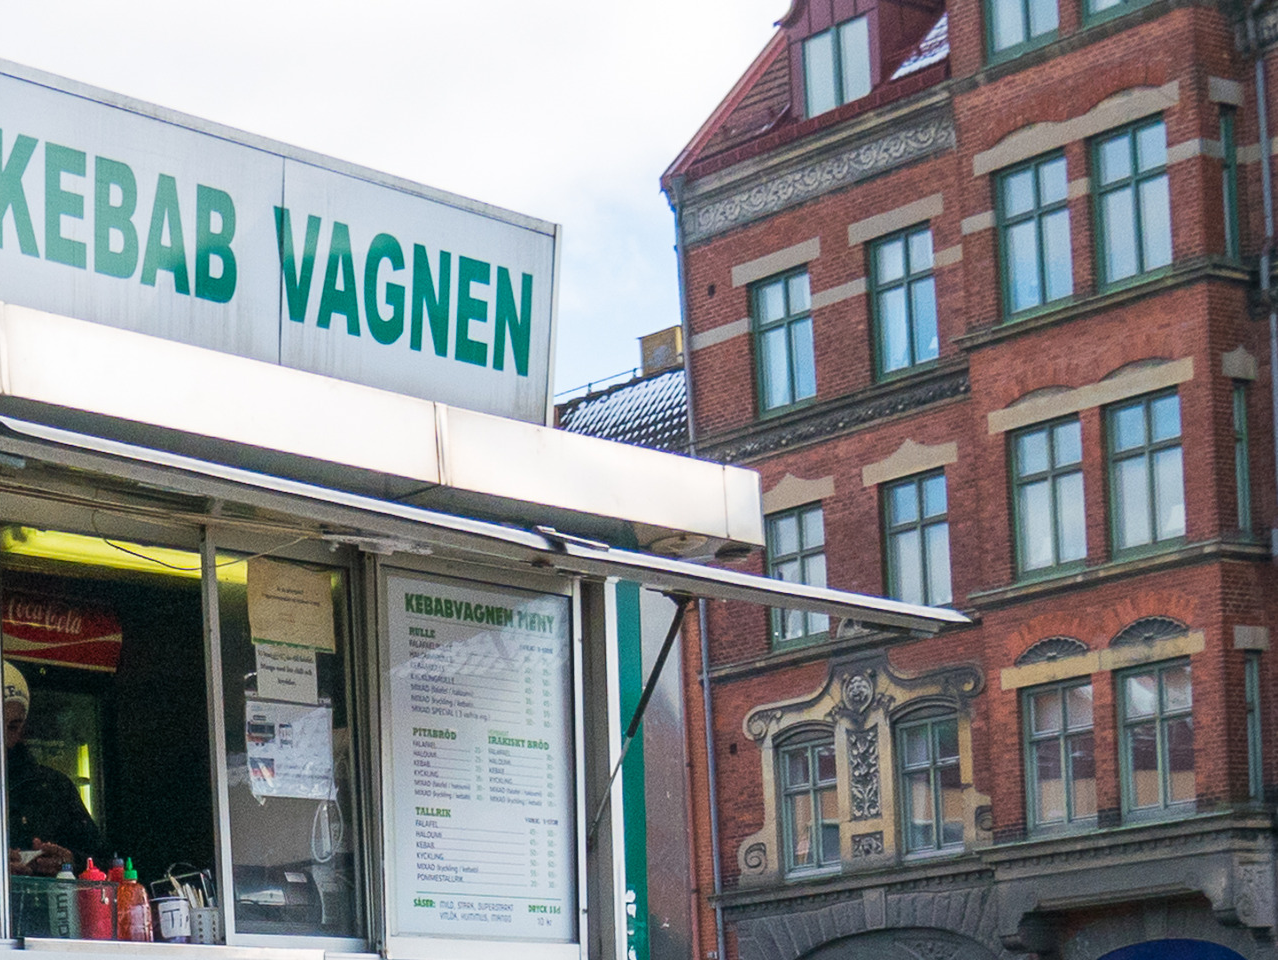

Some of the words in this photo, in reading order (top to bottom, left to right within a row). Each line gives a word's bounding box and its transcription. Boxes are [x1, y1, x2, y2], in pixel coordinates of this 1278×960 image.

[273, 205, 533, 378] VAGNEN
[404, 593, 513, 628] KEBABVAGNEN
[517, 612, 555, 634] MENY
[415, 806, 451, 817] TALLRIK
